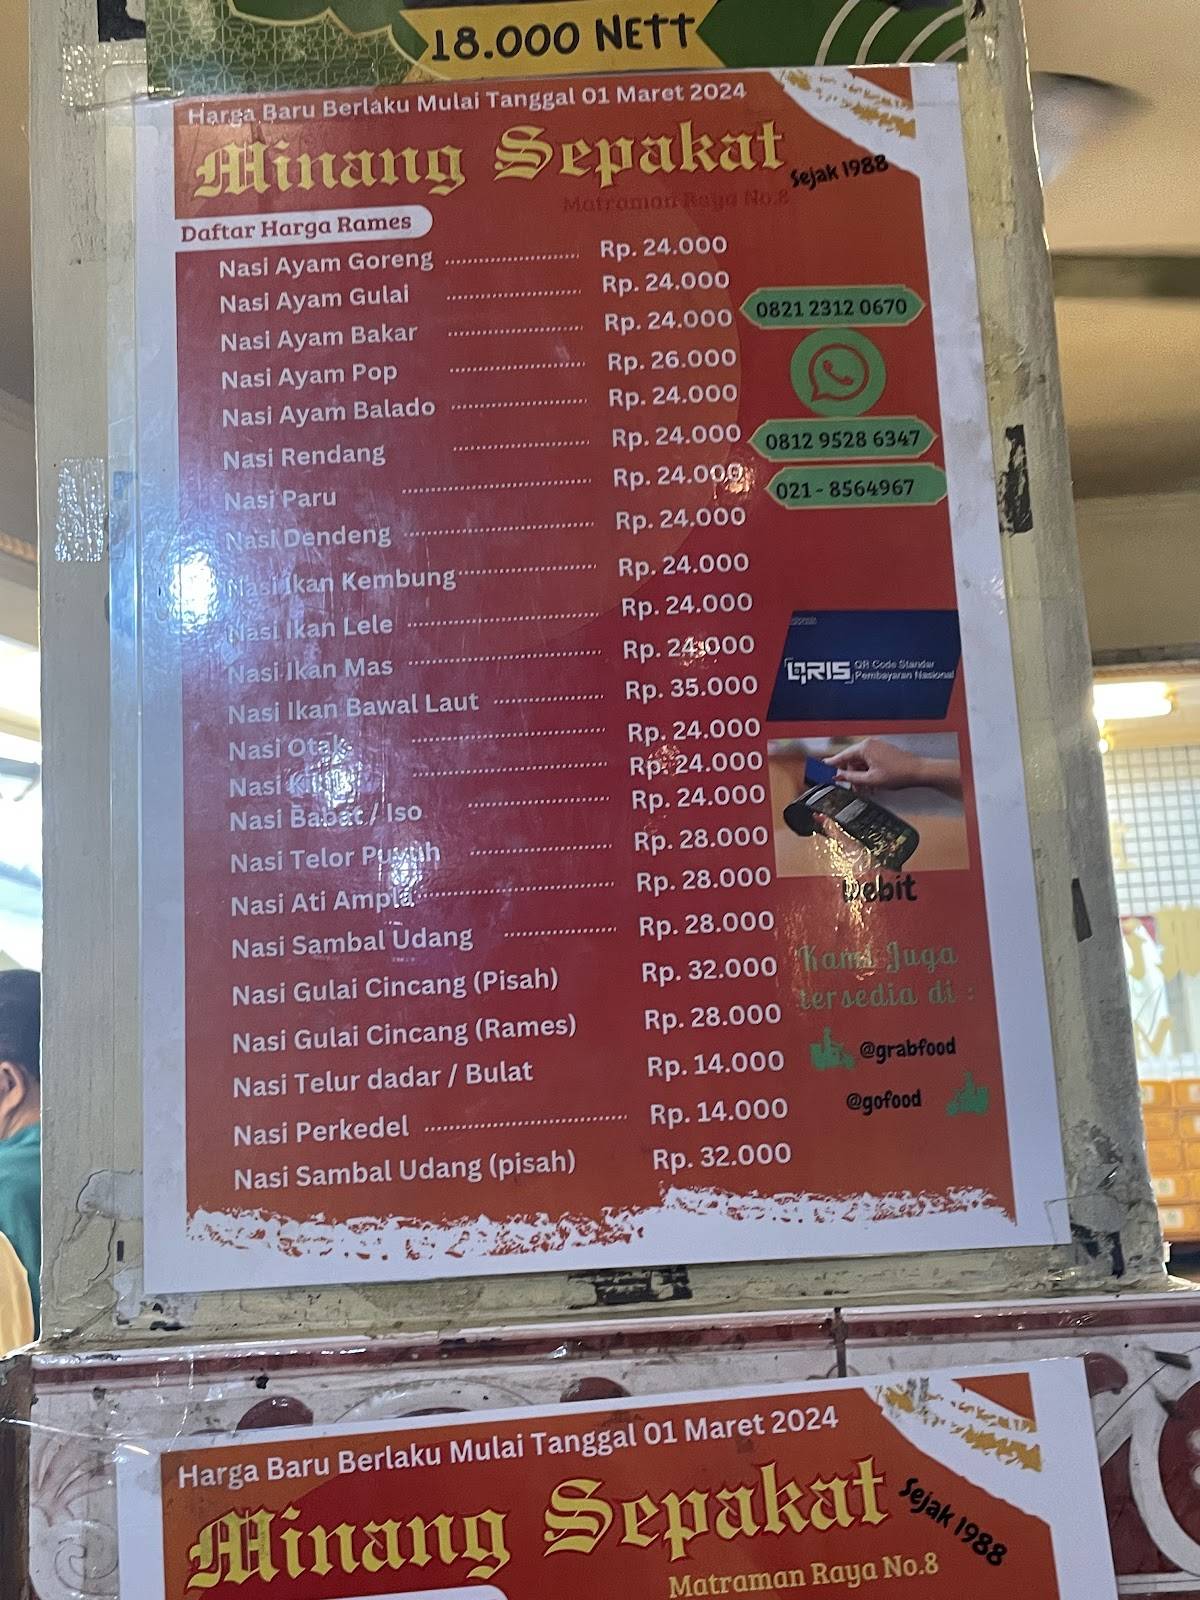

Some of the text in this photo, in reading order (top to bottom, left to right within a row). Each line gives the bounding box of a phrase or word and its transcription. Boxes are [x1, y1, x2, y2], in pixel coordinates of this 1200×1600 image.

[432, 21, 579, 62] 18.000
[188, 81, 746, 126] Harga Baru Berlaku Mulai Tanggal 01 Maret 2024
[193, 120, 785, 197] Minang Sepakat
[790, 154, 889, 190] Sejak 1988
[180, 213, 412, 243] Daftar Harga Rames
[219, 236, 727, 279] Nasi Ayam Goreng Rp. 24.000
[220, 271, 730, 314] Nasi Ayam Gulai Rp. 24.000
[756, 298, 907, 318] 0821 2312 0670
[221, 309, 733, 352] Nasi Ayam Bakar Rp. 24.000
[221, 349, 737, 390] Nasi Ayam Pop Rp. 26.000
[222, 384, 738, 428] Nasi Ayam Balado Rp. 24.000
[223, 424, 742, 471] Nasi Rendang Rp. 24.000
[766, 430, 920, 450] 0812 9528 6347
[282, 468, 651, 508] Paru Rp.
[776, 479, 915, 499] 021 8564967
[284, 507, 746, 549] Dendeng Rp. 24.000
[342, 553, 750, 591] Kembung Rp. 24.000
[286, 592, 753, 640] Ikan Lele Rp. 24.000
[227, 640, 661, 684] Nasi Ikan Mas Rp.
[787, 660, 851, 685] QRIS
[228, 675, 758, 724] Nasi Ikan Bawal Laut Rp. 35.000
[229, 718, 761, 761] Nasi Rp. 24.000
[675, 751, 763, 774] 24.000
[230, 784, 765, 832] Nasi Iso Rp. 24.000
[231, 826, 768, 873] Nasi Telor Rp. 28.000
[231, 867, 771, 916] Nasi Ati Rp. 28.000
[232, 911, 775, 959] Nasi Sambal Udang Rp. 28.000
[886, 941, 957, 973] Juga
[232, 957, 777, 1006] Nasi Gulai Cincang (Pisah) Rp. 32.000
[232, 1003, 782, 1054] Nasi Gulai Cincang (Rames) Rp. 28.000
[859, 1036, 957, 1064] @grabfood
[233, 1051, 785, 1098] Nasi Telur dadar Bulat Rp. 14.000
[233, 1098, 788, 1147] Nasi Perkedel Rp. 14.000
[846, 1088, 922, 1115] @gofood
[234, 1143, 791, 1191] Nasi Sambal Udang (pisah) Rp. 32.000
[178, 1405, 838, 1489] Harga Baru Berlaku Mulai Tanggal 01 Maret 2024
[187, 1455, 890, 1590] Minang Sepakat
[898, 1476, 1008, 1566] Sejak 1988
[669, 1552, 940, 1599] Matraman Raya No.8
